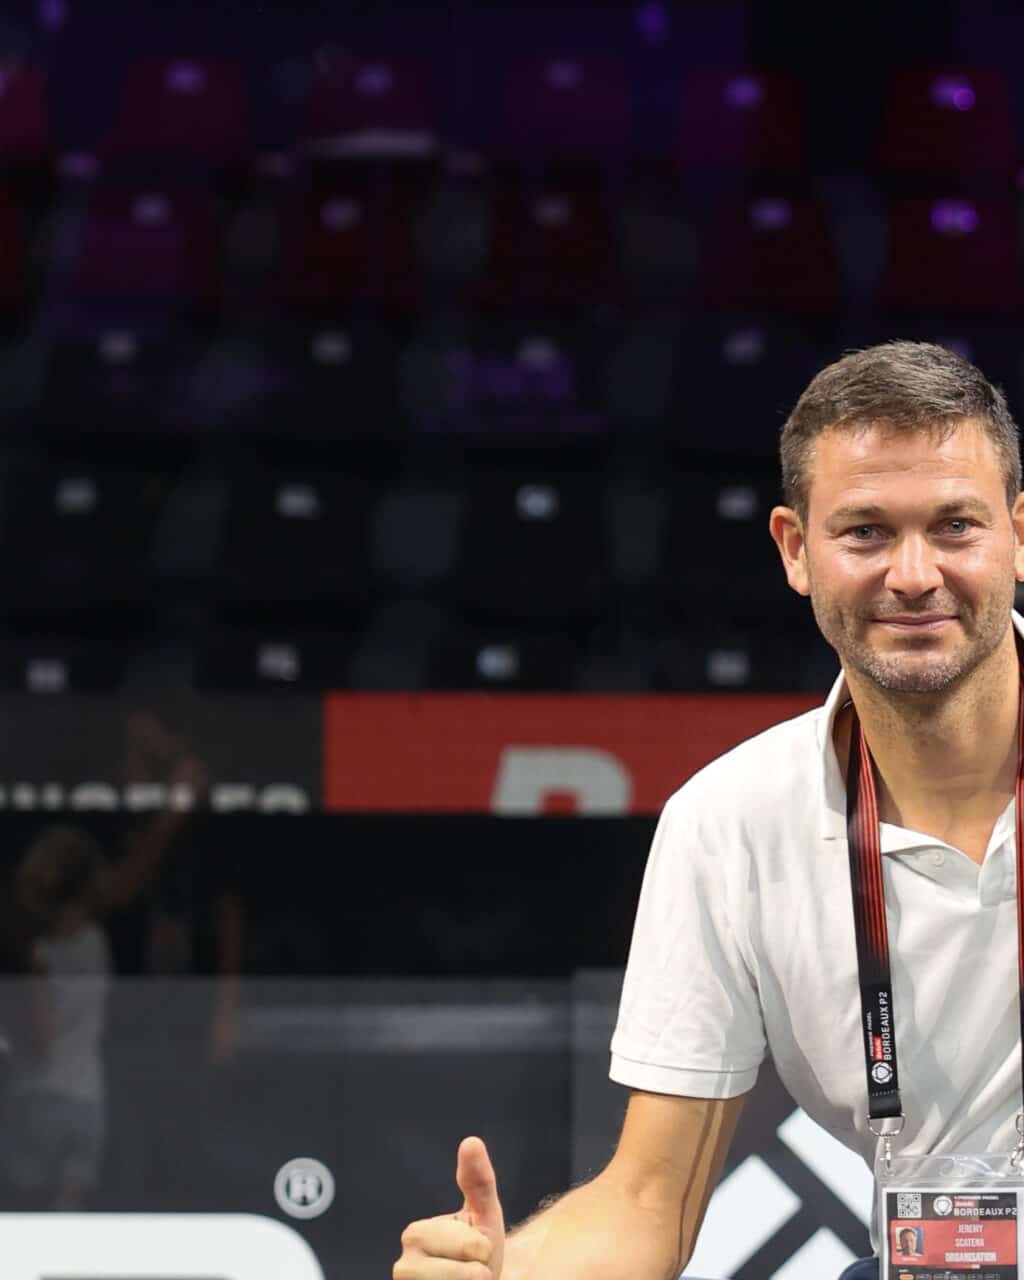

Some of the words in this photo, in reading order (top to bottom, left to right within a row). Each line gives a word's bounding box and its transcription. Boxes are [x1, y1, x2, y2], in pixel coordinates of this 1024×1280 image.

[878, 992, 888, 1005] P2
[879, 1007, 892, 1060] BORDEAUX
[953, 1207, 1003, 1216] BORDEAUX
[1005, 1207, 1017, 1216] P2
